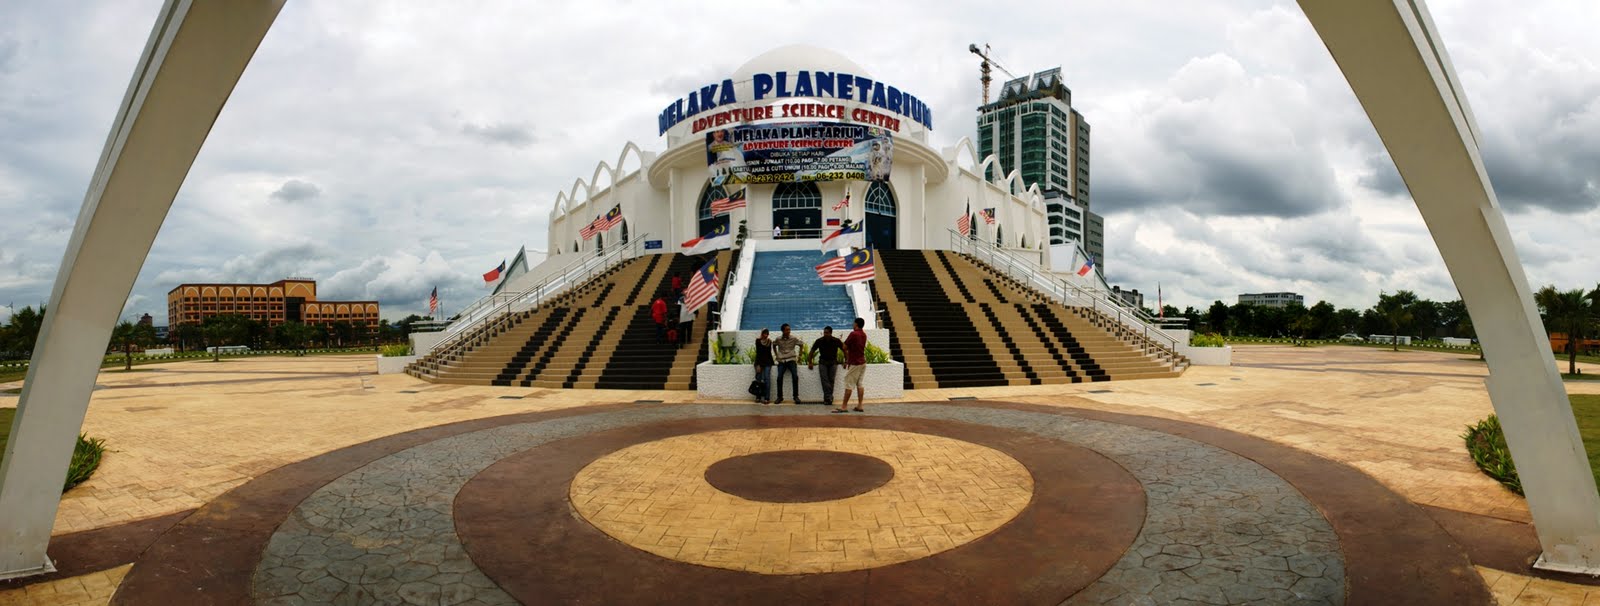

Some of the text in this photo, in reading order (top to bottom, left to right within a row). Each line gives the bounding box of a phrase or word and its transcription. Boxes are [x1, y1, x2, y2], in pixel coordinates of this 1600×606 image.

[658, 70, 932, 137] MELAKA PLANETARIUM
[692, 103, 900, 134] ADVENTURE SCIENCE CENTRE
[733, 126, 864, 143] MELAKA PLANETARIUM
[743, 141, 789, 151] ADVENTURE
[790, 140, 823, 149] SCIENCE
[823, 139, 854, 148] CENTRE
[774, 172, 795, 181] 2424
[816, 172, 844, 180] 06-232
[845, 171, 866, 180] 0408
